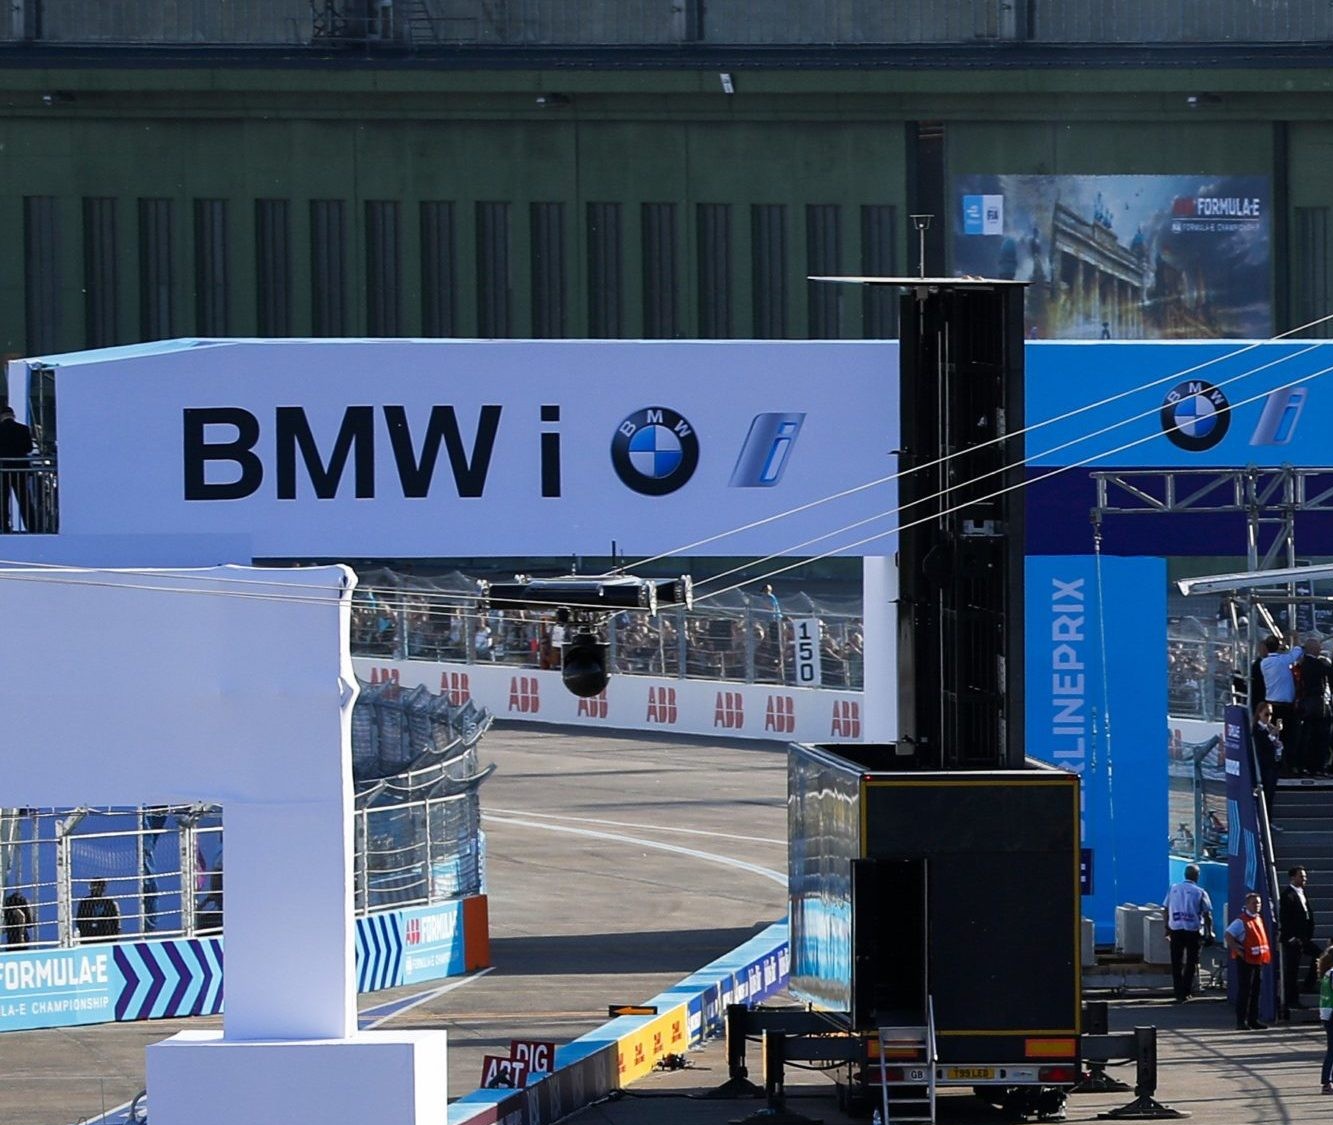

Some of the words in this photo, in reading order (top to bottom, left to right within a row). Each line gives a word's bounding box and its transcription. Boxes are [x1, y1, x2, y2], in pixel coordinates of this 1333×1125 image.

[1197, 198, 1260, 216] FORMULA-E
[183, 405, 503, 502] BMW
[541, 405, 561, 498] i
[799, 622, 814, 682] 150
[509, 677, 540, 713] ABB
[646, 687, 678, 723] ABB
[715, 692, 744, 729] ABB
[766, 696, 795, 733] ABB
[832, 700, 860, 739] ABB
[32, 997, 109, 1016] CHAMPIONSHIP
[516, 1044, 549, 1074] DIG
